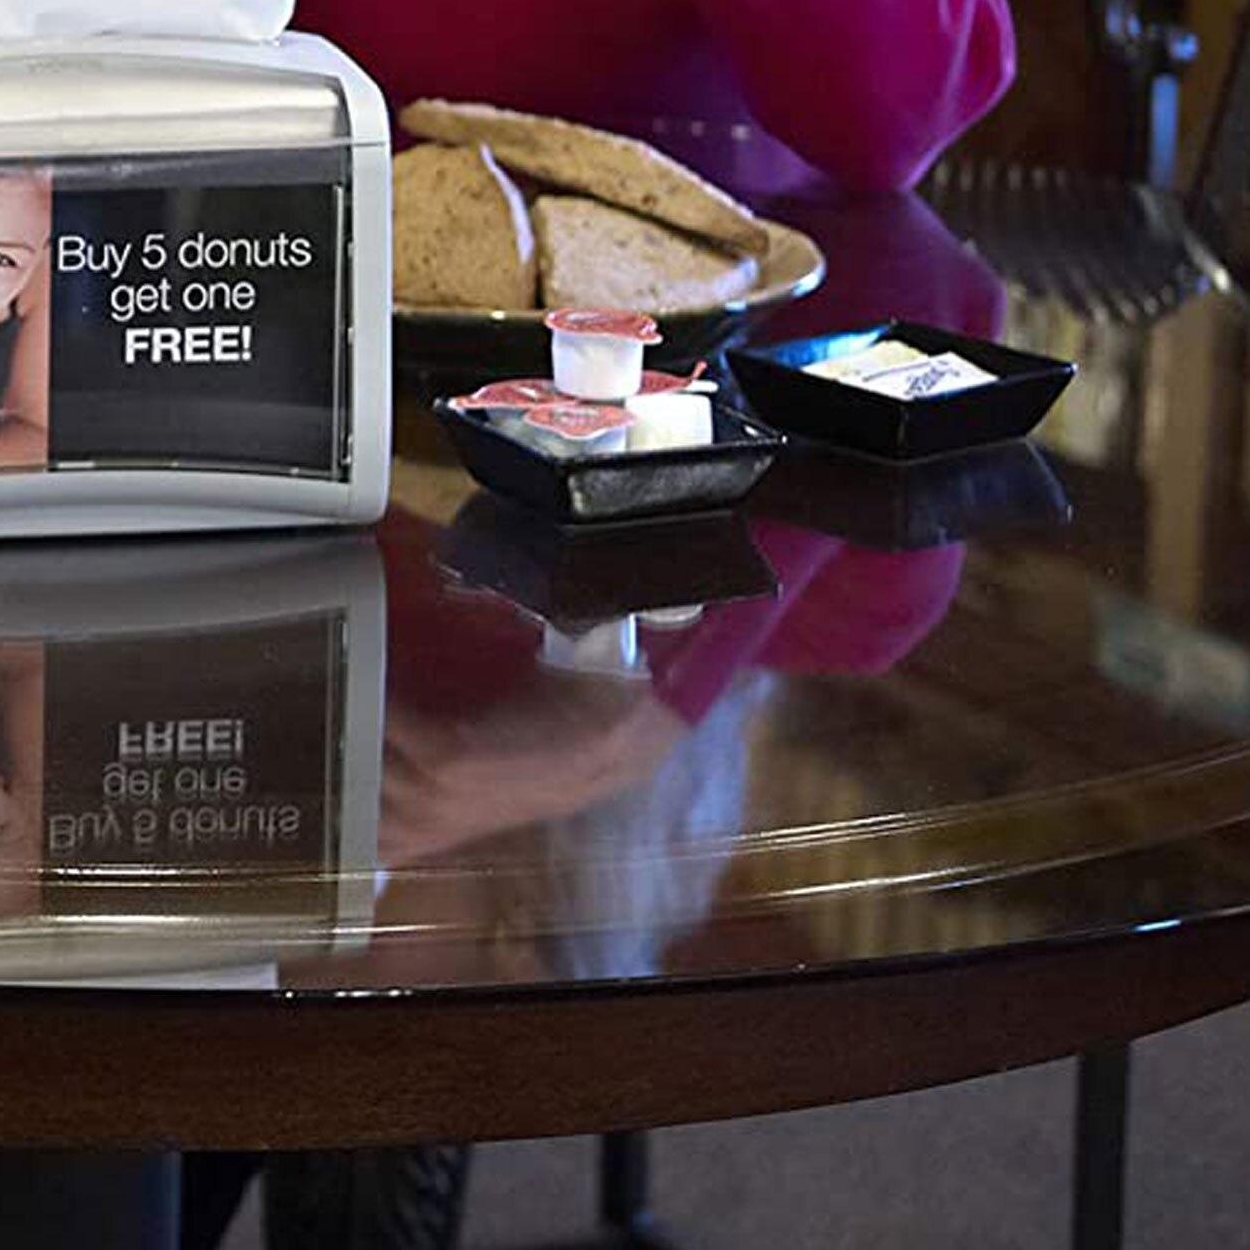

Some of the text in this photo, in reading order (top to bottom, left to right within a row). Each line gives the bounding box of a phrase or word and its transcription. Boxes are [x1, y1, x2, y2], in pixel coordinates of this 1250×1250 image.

[57, 232, 313, 279] Buy 5 donuts
[110, 277, 256, 322] get one
[125, 325, 252, 364] FREE!
